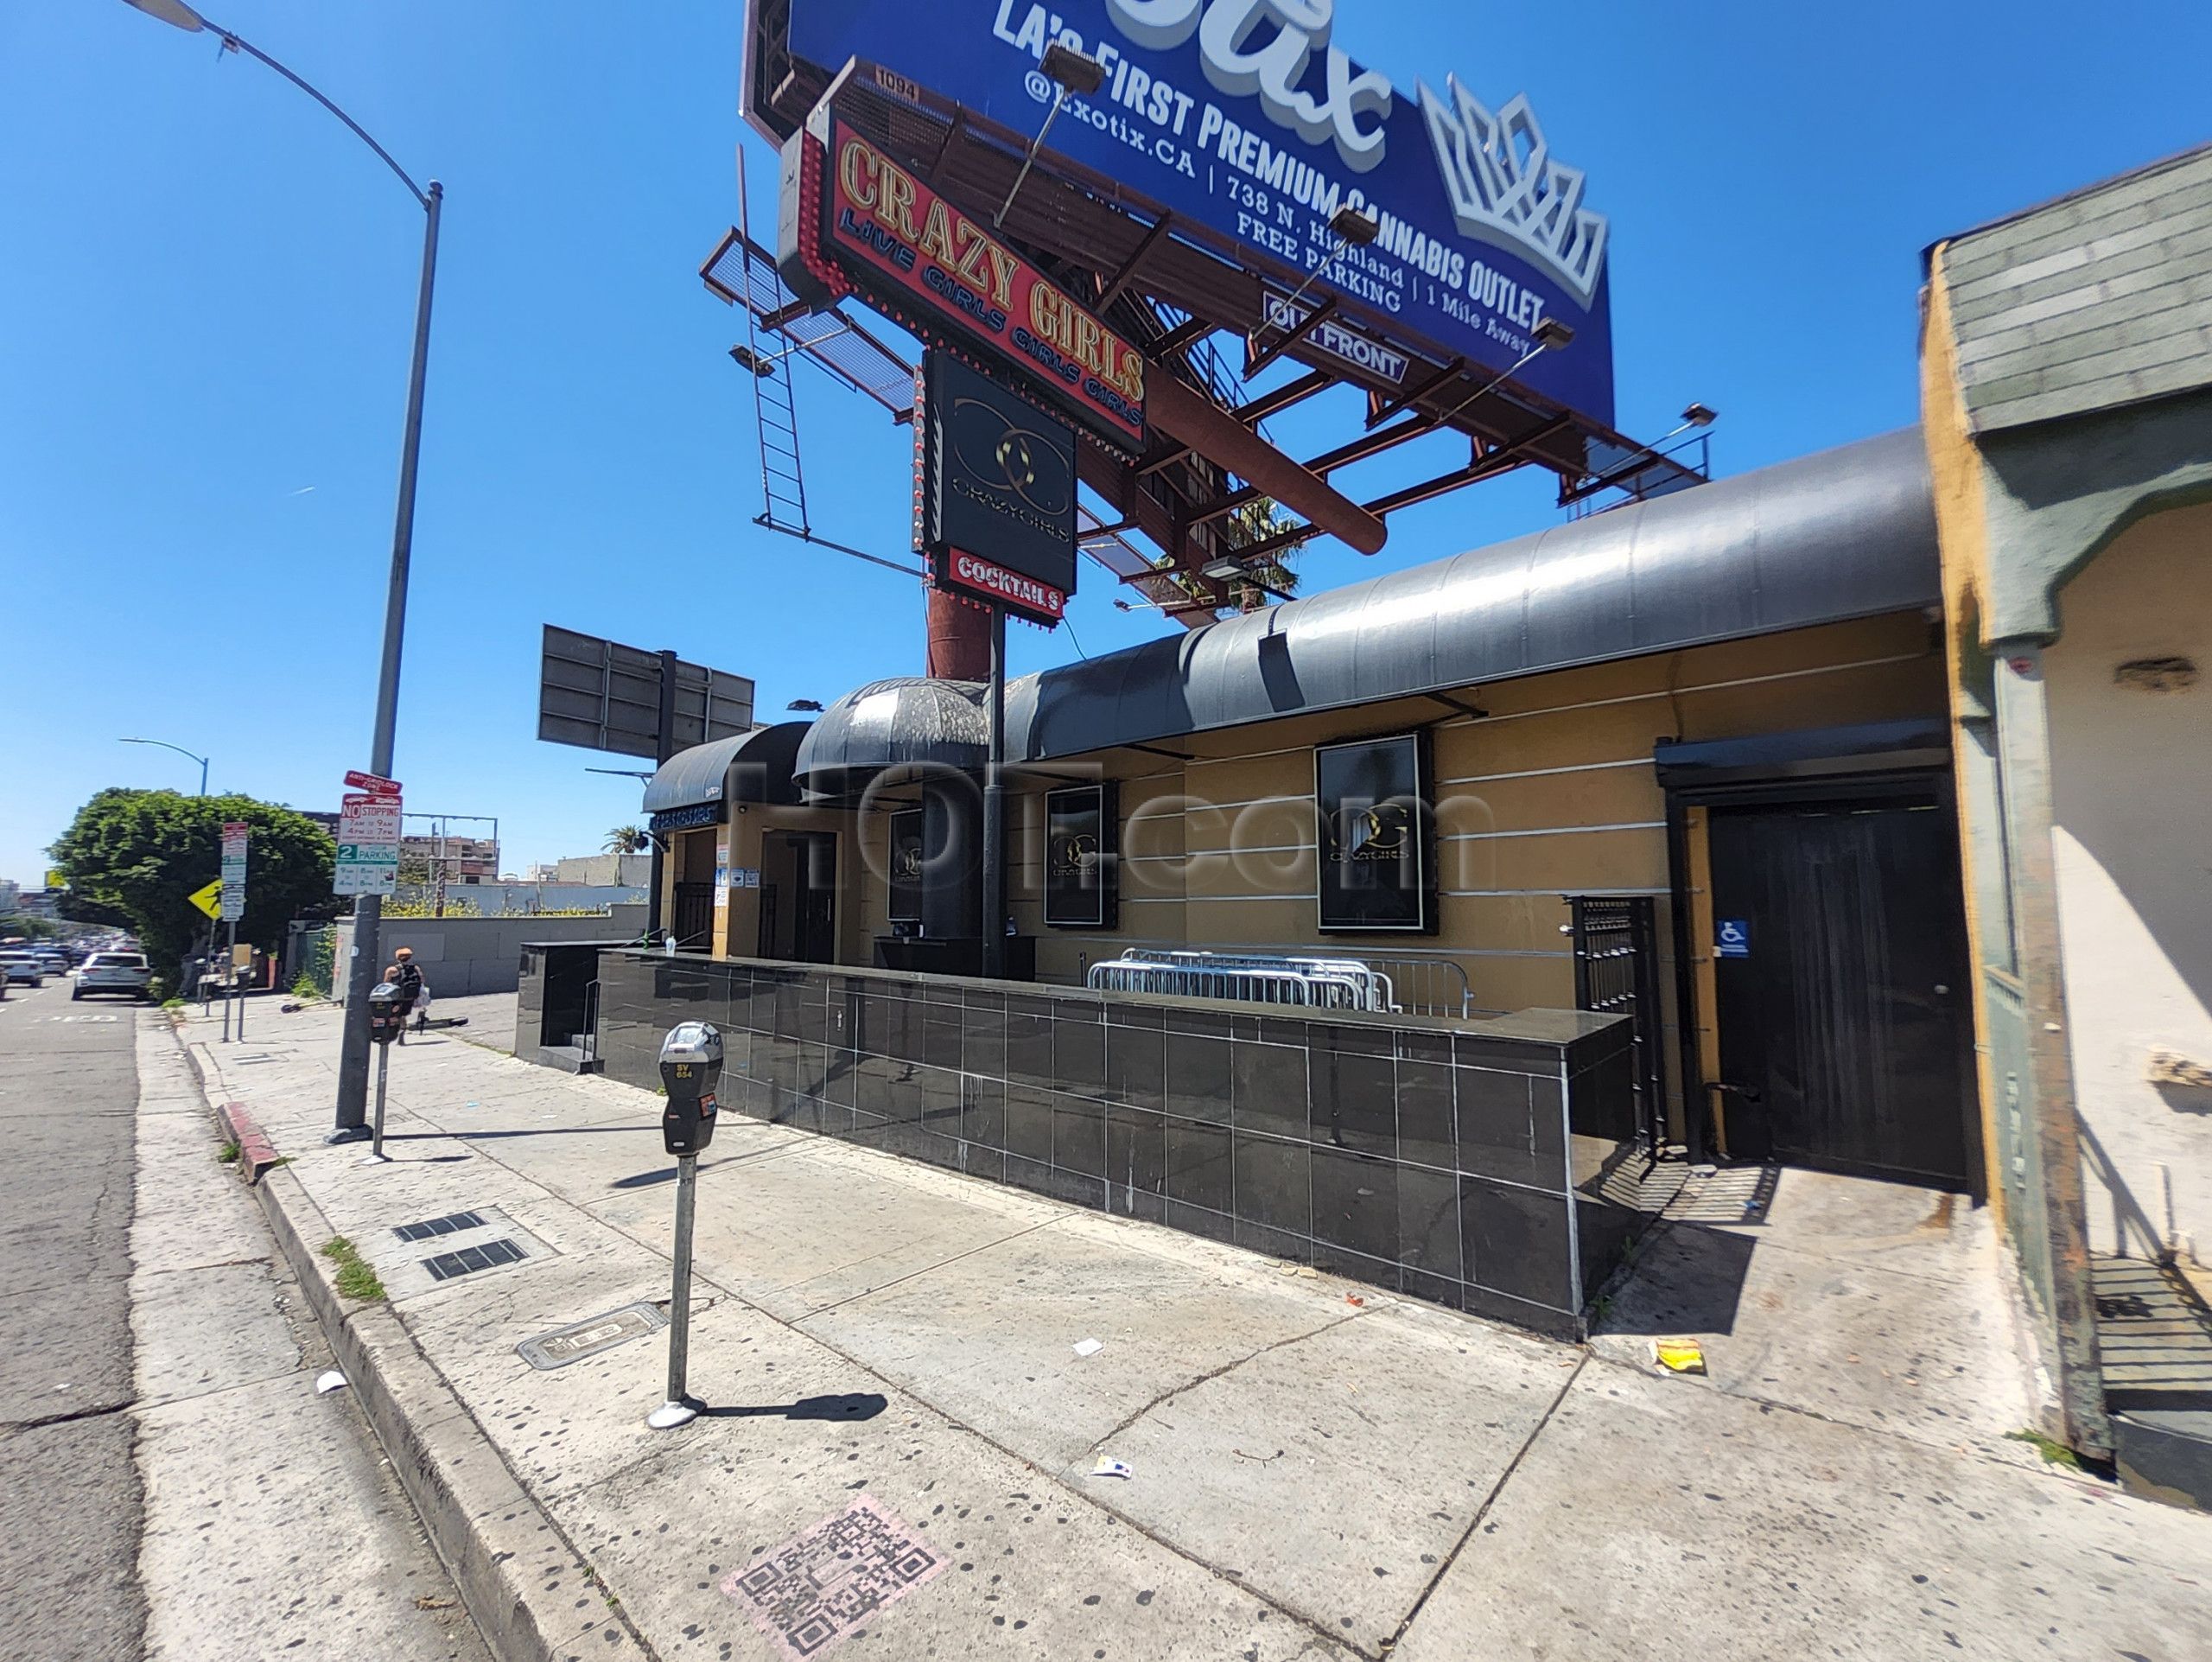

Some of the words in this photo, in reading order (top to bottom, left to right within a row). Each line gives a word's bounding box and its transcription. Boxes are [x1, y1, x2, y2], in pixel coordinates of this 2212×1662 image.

[879, 69, 914, 99] 1094
[1025, 69, 1196, 179] @Exotix.CA
[1228, 175, 1268, 215] 738
[1310, 220, 1404, 290] Highland
[1442, 292, 1482, 330] Mile
[1477, 317, 1530, 359] Away
[1096, 41, 1194, 136] FIRST
[1198, 102, 1339, 219] PREMIUM
[1468, 260, 1544, 334] OUTLET
[840, 137, 1019, 312] CRAZY
[1029, 279, 1145, 403] GIRLS
[1237, 211, 1298, 262] FREE
[1305, 246, 1401, 313] PARKING
[839, 207, 916, 272] LIVE
[921, 264, 1007, 334] GIRLS
[1011, 326, 1081, 385] GIRLS
[1083, 377, 1144, 427] GIRLS
[957, 556, 1060, 611] COCKTAILS
[340, 845, 353, 859] 2
[359, 850, 396, 861] PARKING
[342, 805, 360, 818] NO
[362, 806, 399, 818] STOPPING
